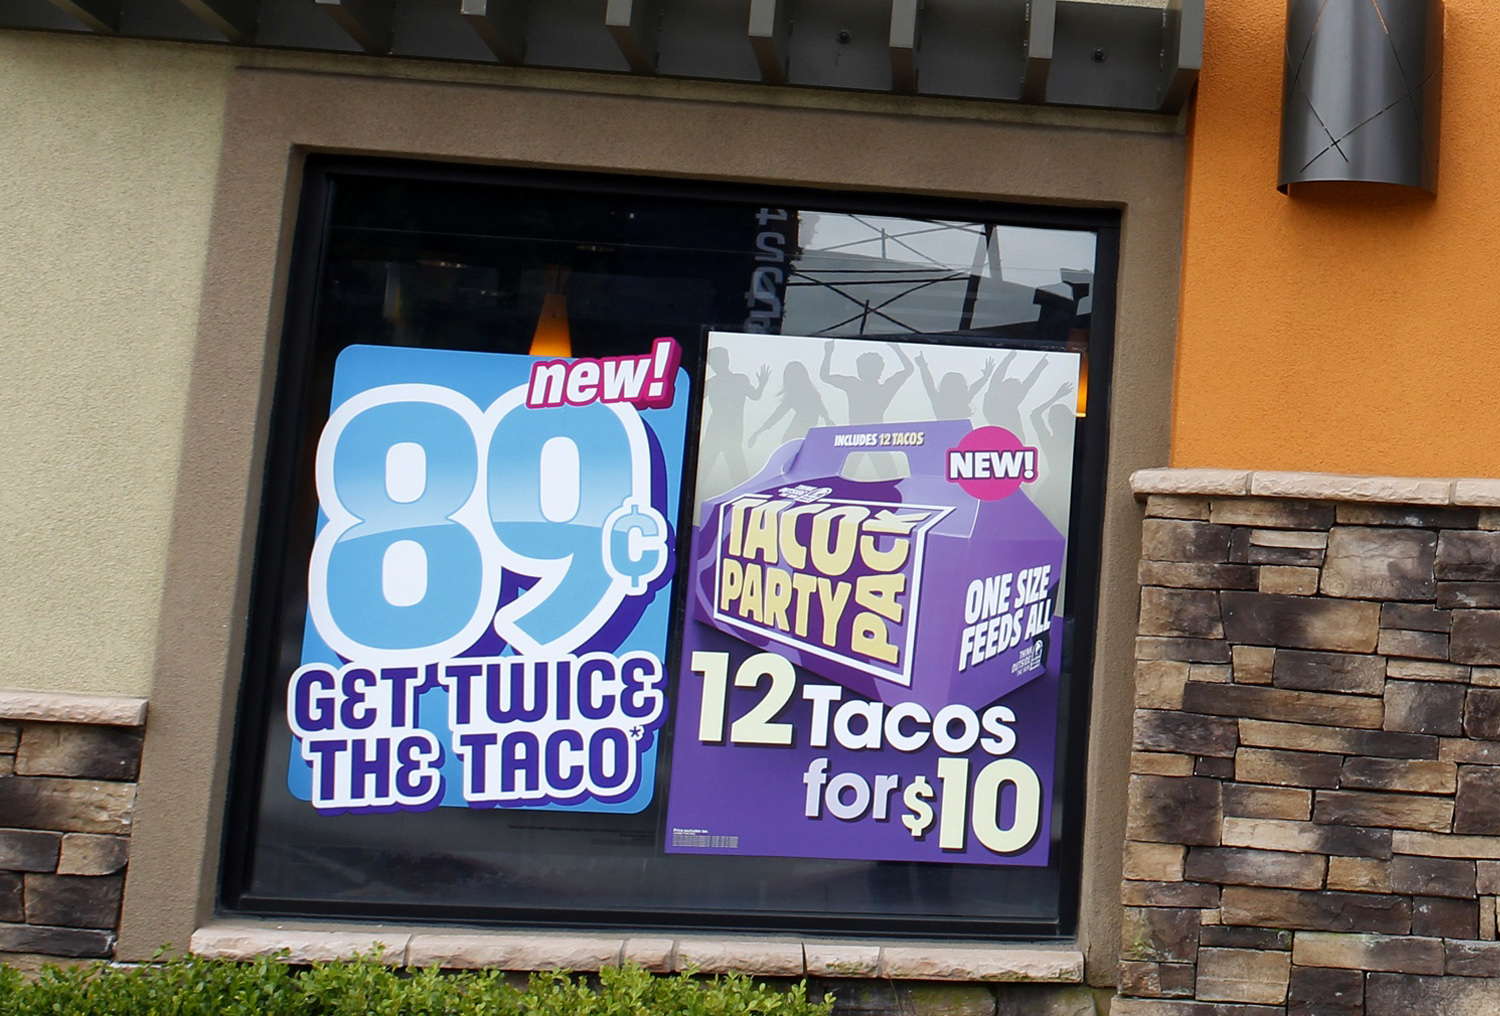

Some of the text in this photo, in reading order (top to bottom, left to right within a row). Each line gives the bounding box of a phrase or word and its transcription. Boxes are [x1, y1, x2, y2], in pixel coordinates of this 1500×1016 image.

[530, 341, 672, 406] new!
[834, 431, 925, 447] INCLUDES 12 TACOS
[949, 450, 1035, 479] NEW!
[318, 392, 665, 654] 89¢
[728, 498, 871, 576] TACO
[720, 557, 852, 648] PARTY
[851, 509, 932, 665] PACK
[964, 564, 1051, 624] ONE SIZE
[958, 598, 1052, 672] FEEDS ALL
[294, 657, 657, 731] GET TWICE
[690, 651, 1017, 755] 12 Tacos
[309, 736, 433, 801] THE
[802, 757, 1042, 853] for $10
